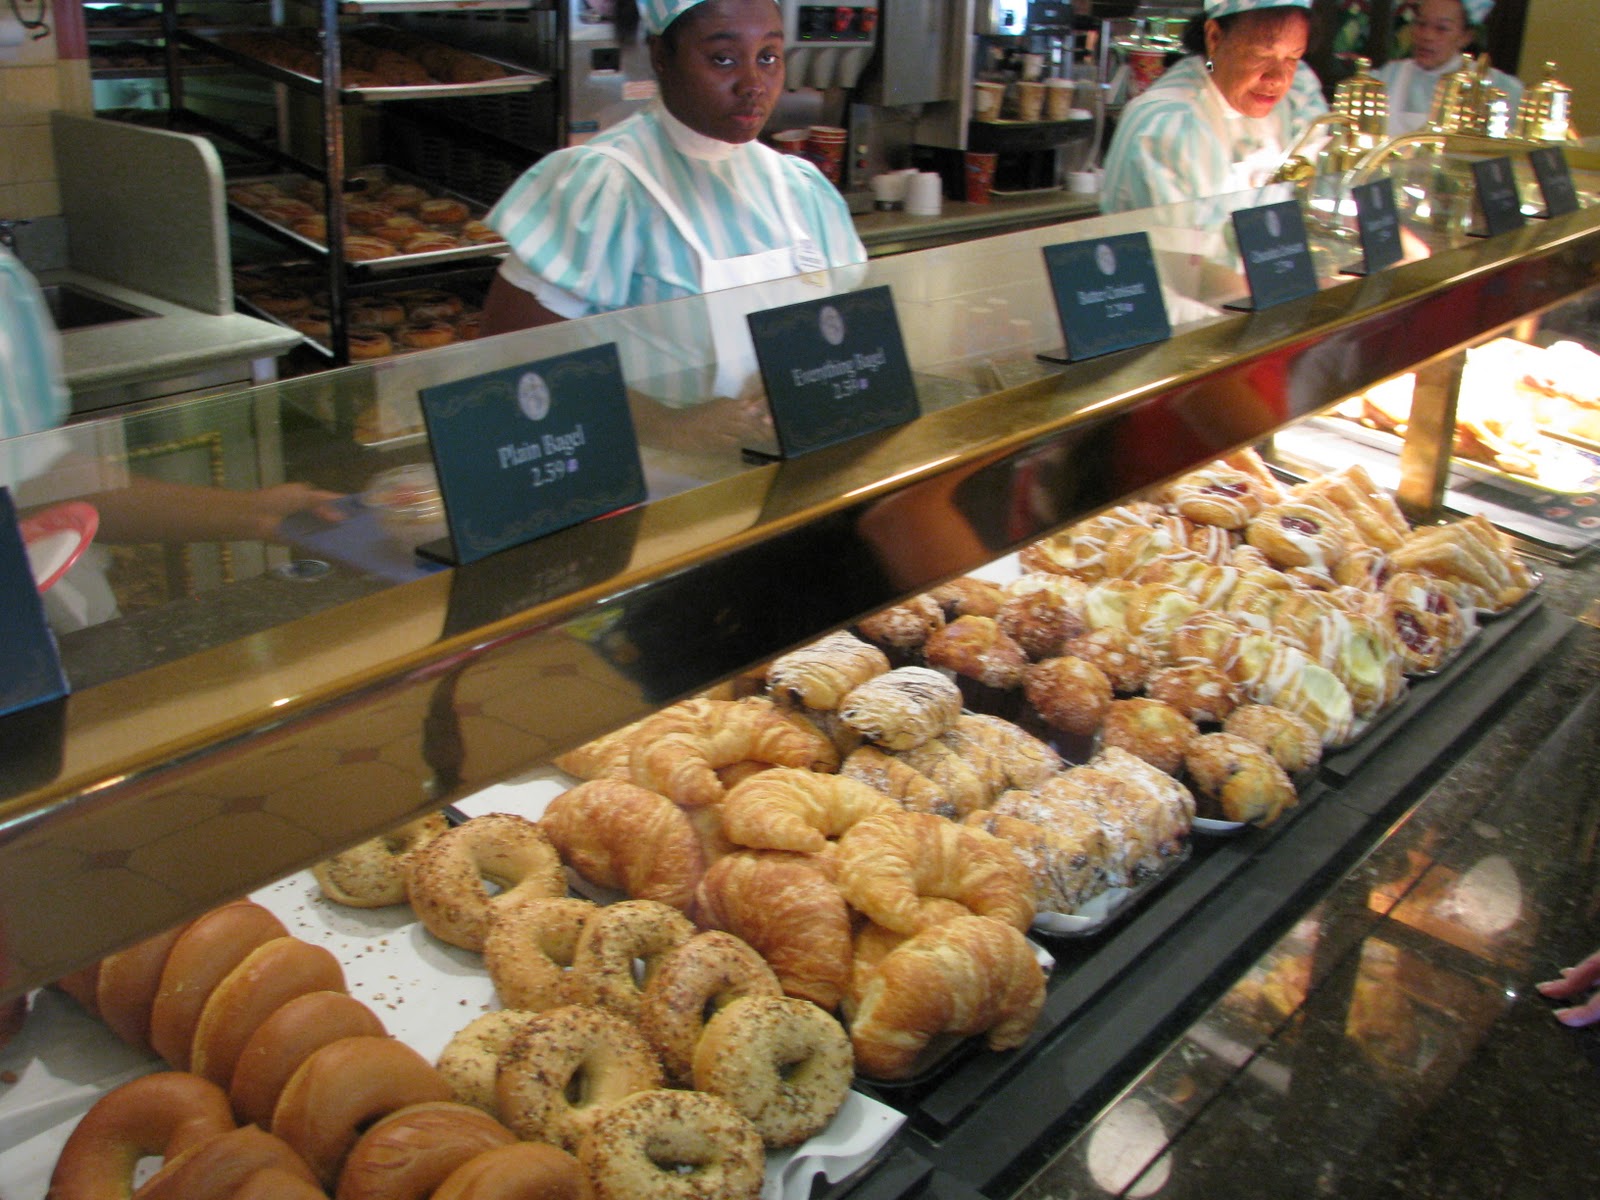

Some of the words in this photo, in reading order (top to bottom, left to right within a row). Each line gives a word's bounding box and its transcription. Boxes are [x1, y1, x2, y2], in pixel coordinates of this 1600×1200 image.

[791, 360, 857, 387] Everything
[853, 347, 887, 372] Bagel
[497, 443, 542, 469] Plain
[541, 424, 586, 455] Bagel
[530, 460, 566, 487] 2.59
